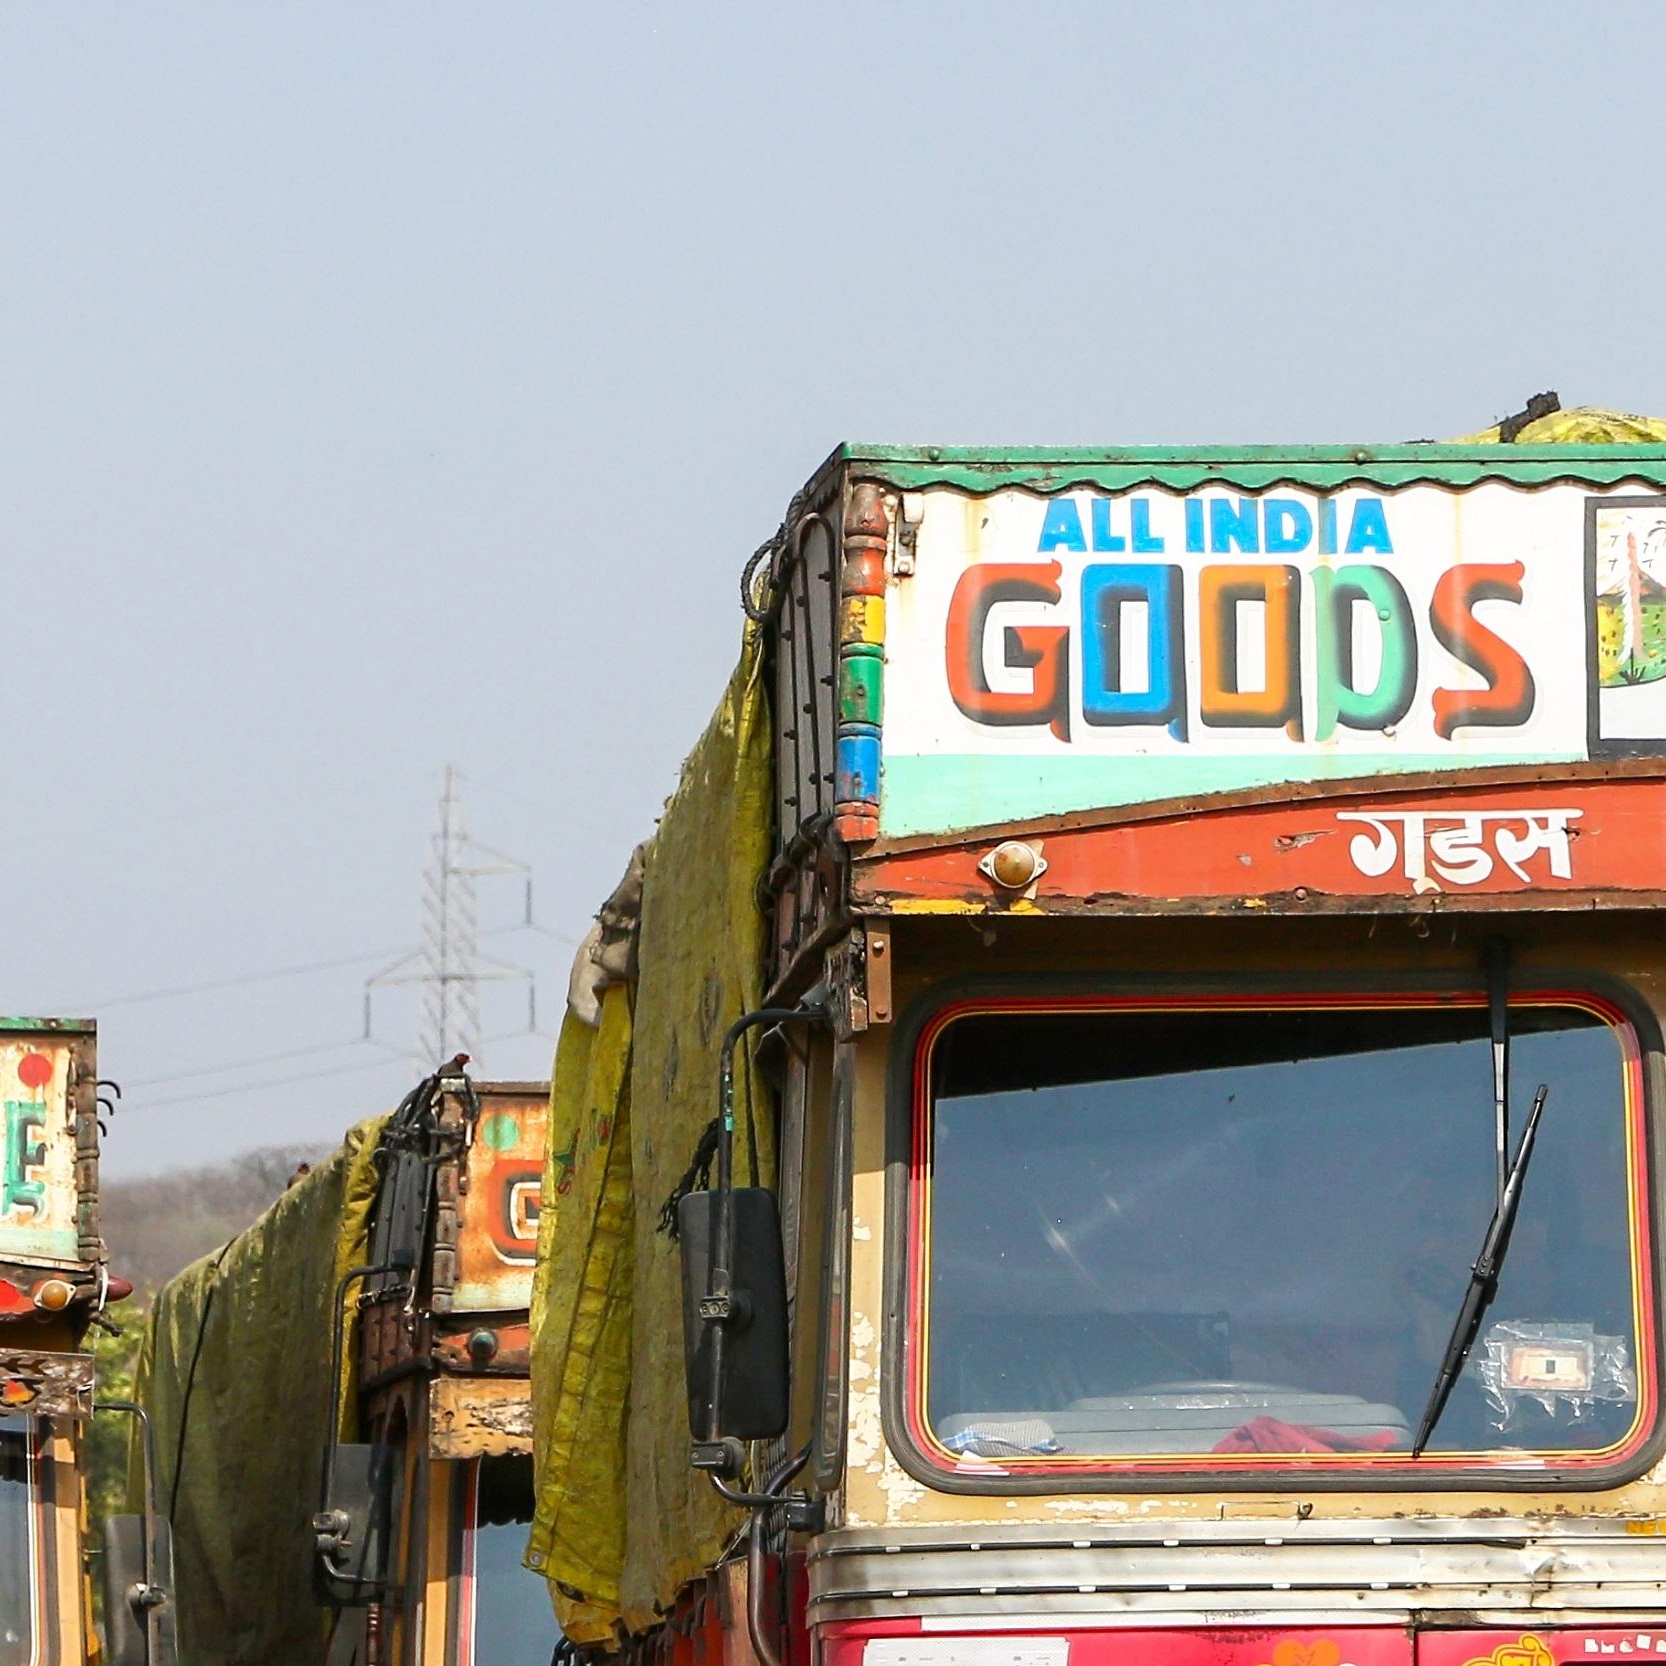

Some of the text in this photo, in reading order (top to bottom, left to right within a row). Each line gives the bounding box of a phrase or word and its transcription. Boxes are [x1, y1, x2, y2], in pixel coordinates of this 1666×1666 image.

[1037, 498, 1394, 555] ALL INDIA
[945, 559, 1536, 743] GOODS
